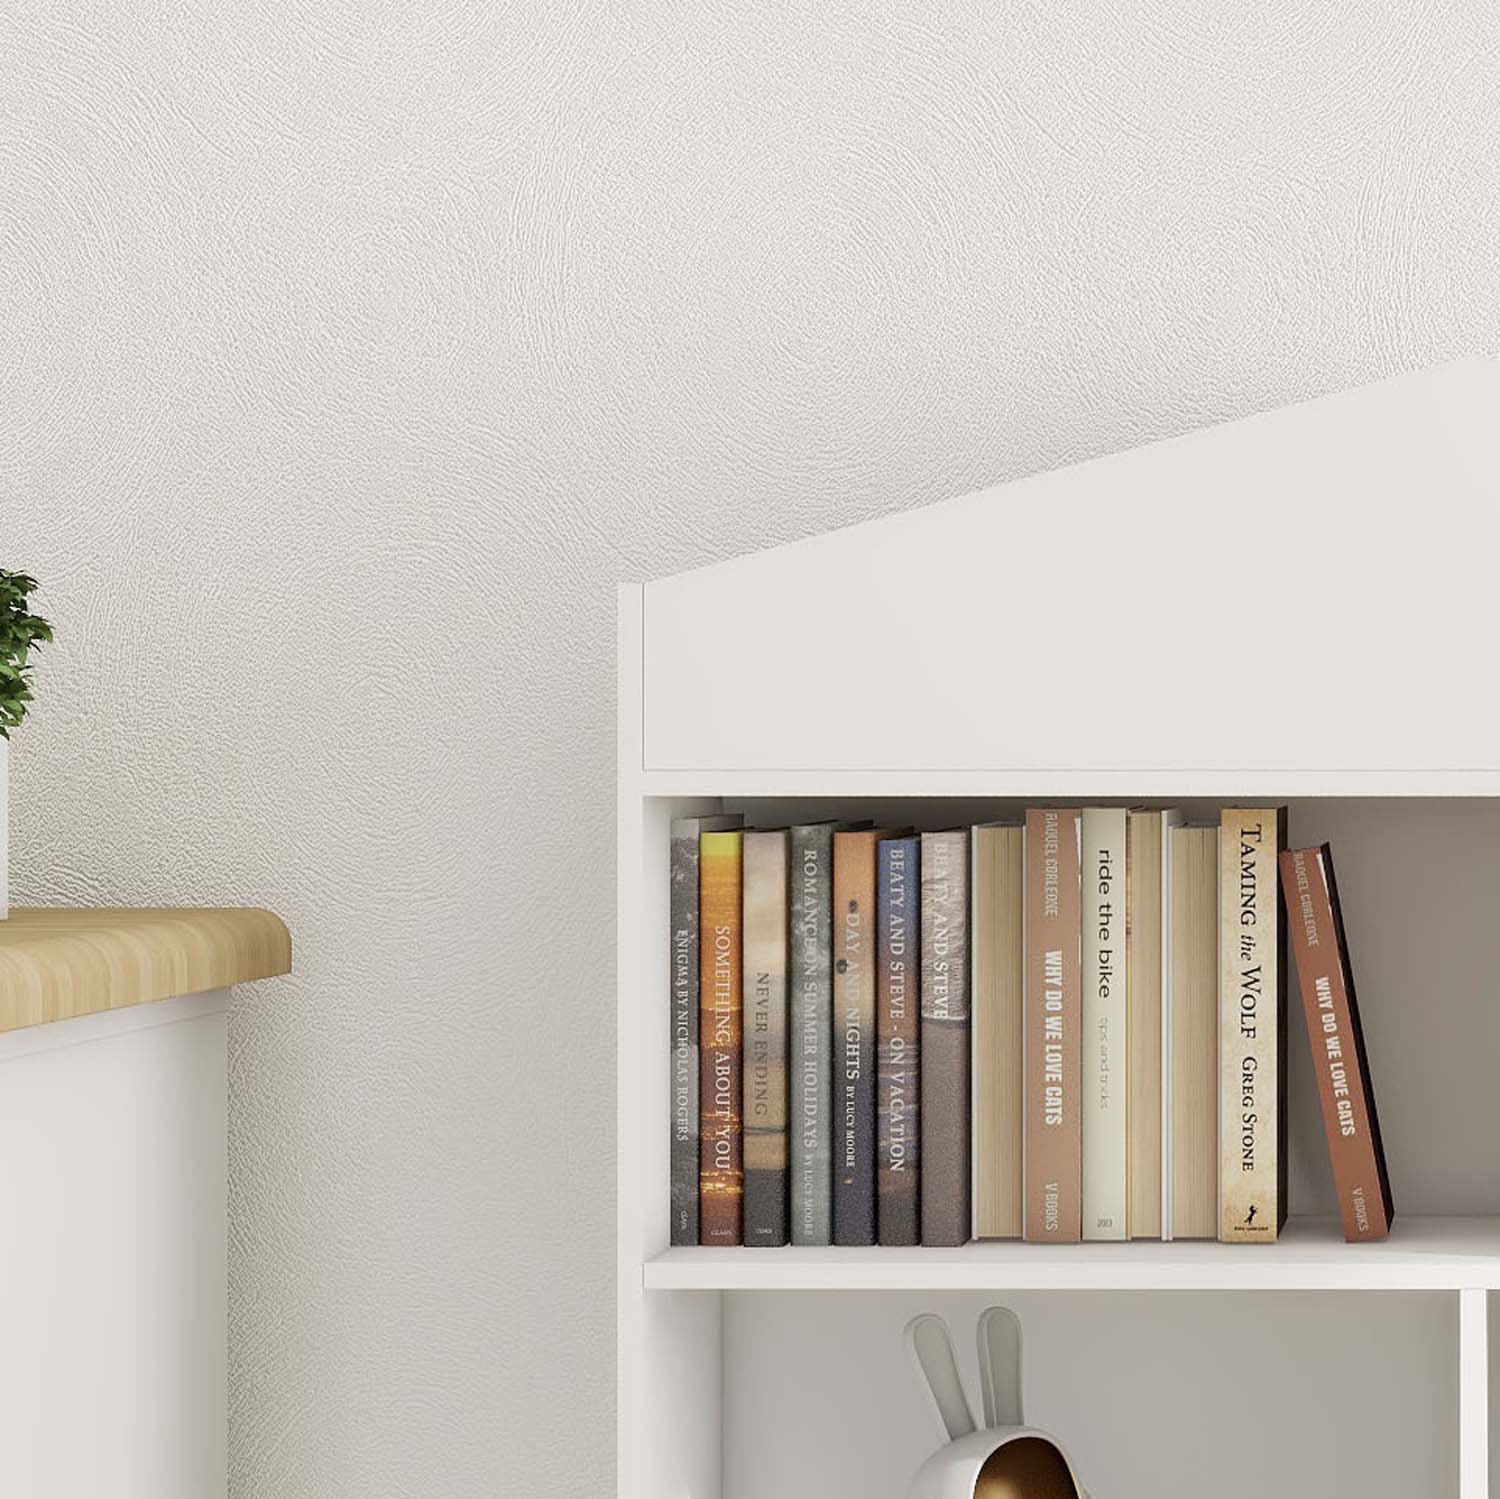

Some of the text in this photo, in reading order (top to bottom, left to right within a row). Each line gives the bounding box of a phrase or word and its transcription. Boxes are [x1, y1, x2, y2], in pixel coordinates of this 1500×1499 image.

[803, 849, 818, 953] ROMANCE
[889, 848, 905, 907] BEATY
[1043, 813, 1059, 917] RAQUEL CORLEONE
[1240, 824, 1262, 926] TAMING
[804, 954, 818, 977] ON
[889, 914, 905, 955] AND
[933, 844, 950, 1019] BEATY AND STEVE
[1098, 850, 1113, 999] ride the bike
[1240, 935, 1256, 961] the
[677, 929, 689, 1141] ENIGMA BY NICHOLAS ROGERS
[804, 982, 818, 1055] SUMMER
[845, 913, 861, 1167] DAY AND NIGHTS BY LUCY MOORE
[889, 961, 905, 1019] STEVE
[1045, 951, 1063, 1125] WHY DO WE LOVE CATS
[714, 926, 731, 1169] SOMETHING ABOUT YOU
[754, 971, 770, 1116] NEVER ENDING
[889, 1037, 905, 1065] ON
[1099, 1045, 1110, 1071] and
[1314, 976, 1356, 1137] WHY DO WE LOVE CATS
[803, 1061, 818, 1149] HOLIDAYS
[889, 1073, 906, 1172] VACATION
[1241, 1056, 1258, 1172] GREG STONE
[1045, 1183, 1059, 1232] V BOOKS
[1351, 1187, 1370, 1233] V BOOKS
